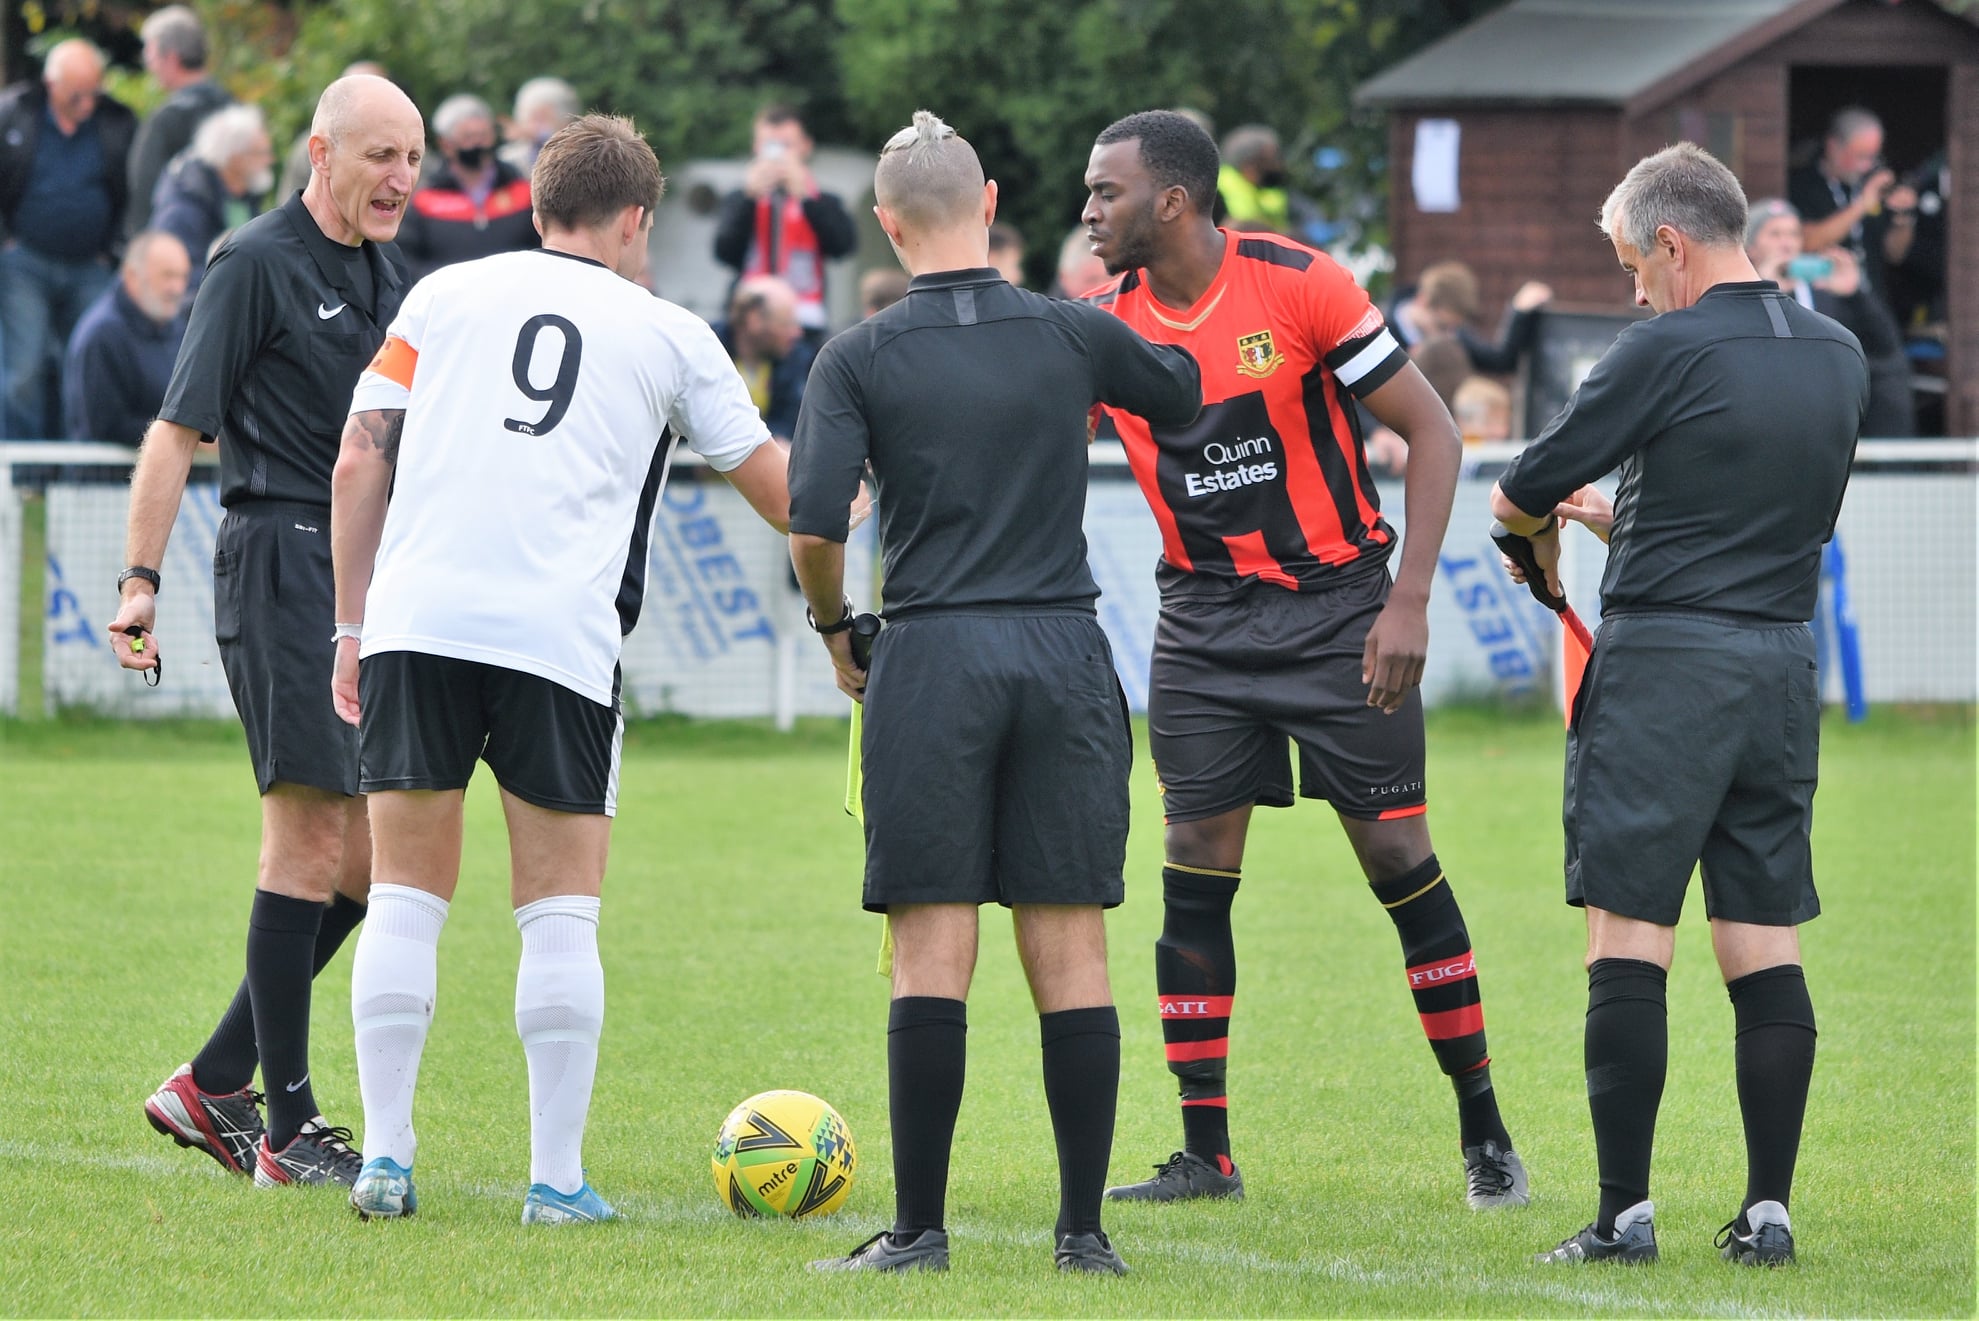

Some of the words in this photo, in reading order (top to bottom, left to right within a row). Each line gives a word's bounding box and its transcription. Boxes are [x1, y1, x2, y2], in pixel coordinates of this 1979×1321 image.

[504, 314, 583, 437] 9
[1203, 436, 1272, 465] Quinn
[1184, 462, 1278, 497] Estates
[1440, 555, 1535, 698] BEST
[1370, 781, 1421, 795] FUGATI
[758, 1162, 798, 1198] mitre
